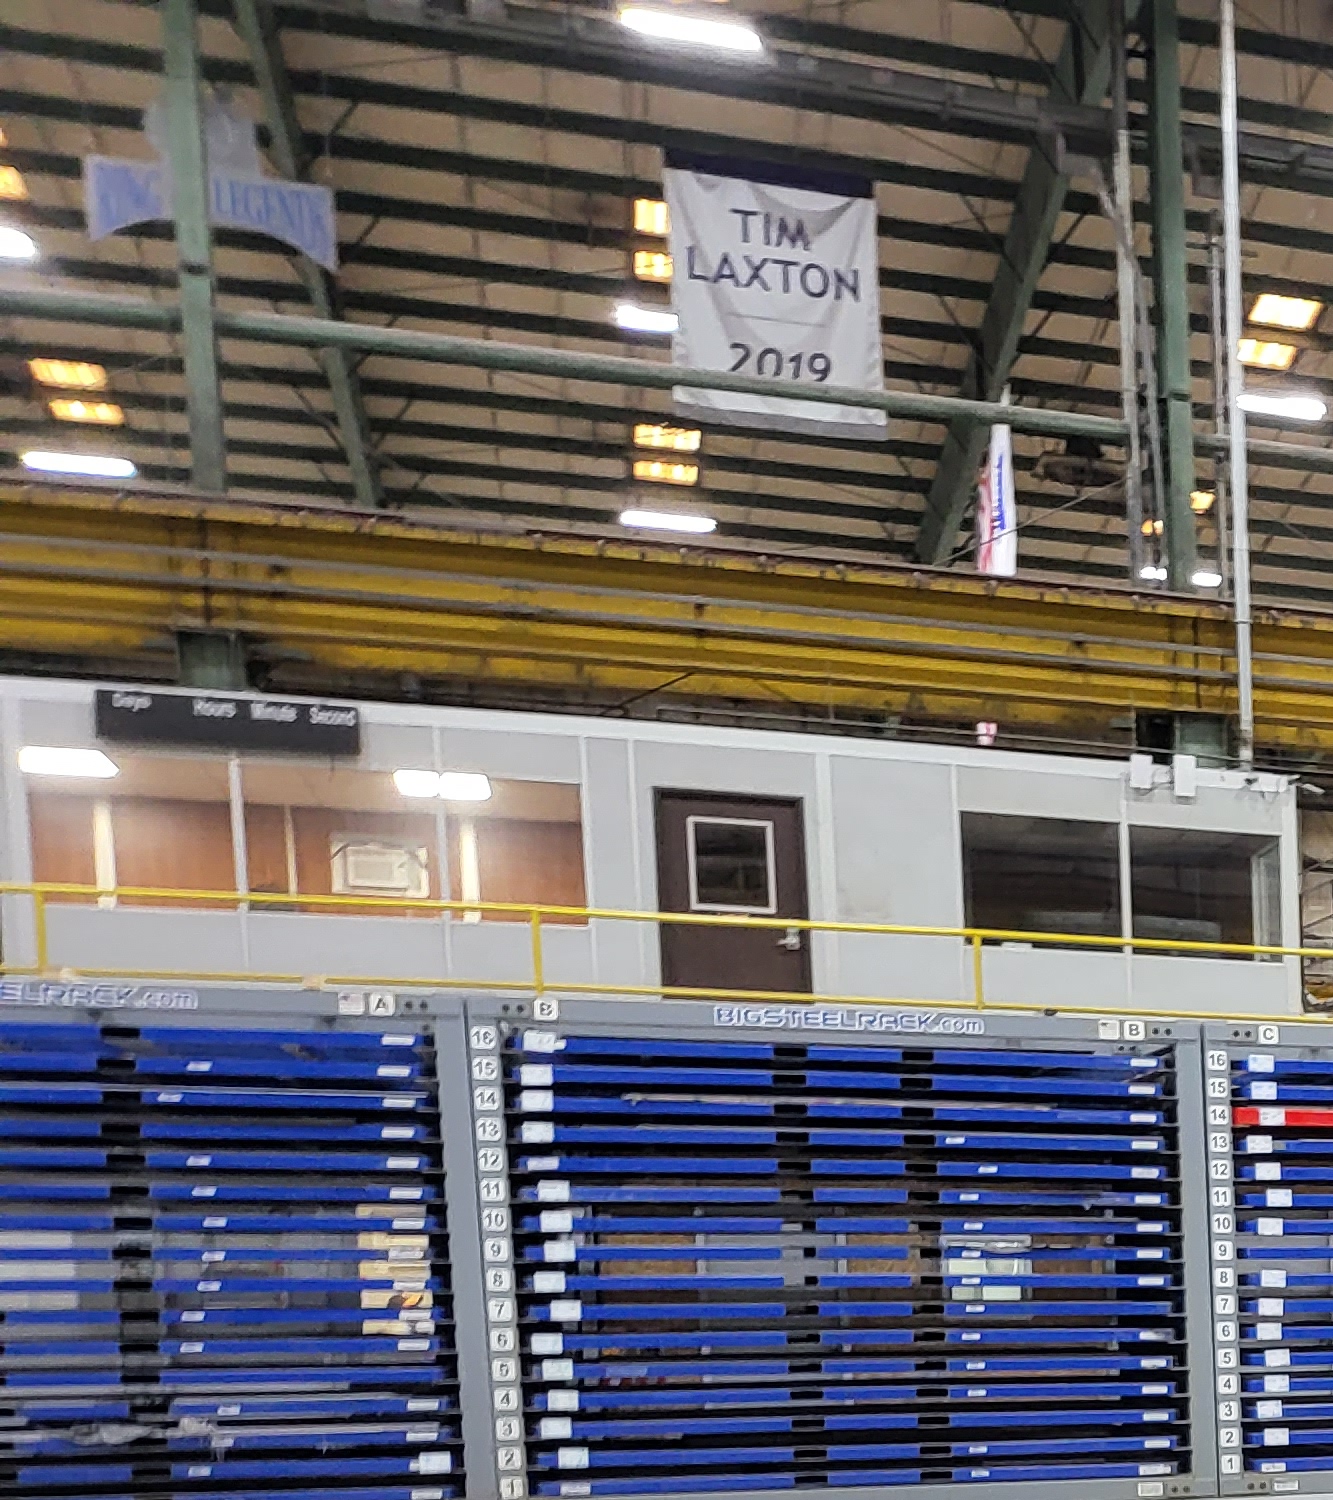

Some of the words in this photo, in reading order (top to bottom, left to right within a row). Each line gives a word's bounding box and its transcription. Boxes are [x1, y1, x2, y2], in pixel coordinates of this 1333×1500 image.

[729, 208, 811, 251] TIM
[686, 245, 861, 302] LAXTON
[730, 342, 832, 382] 2019
[714, 1006, 985, 1035] BIGSTEELRACK.com
[1128, 1023, 1140, 1037] B
[1262, 1027, 1275, 1041] C
[1209, 1054, 1226, 1067] 16
[1210, 1081, 1226, 1094] 15
[1210, 1109, 1227, 1122] 14
[1212, 1136, 1228, 1149] 13
[479, 1153, 500, 1167] 12
[1212, 1163, 1229, 1176] 12
[482, 1183, 501, 1197] 11
[1213, 1190, 1228, 1203] 11
[485, 1213, 504, 1227] 10
[1214, 1217, 1231, 1230] 10
[1218, 1244, 1227, 1257] 9
[1219, 1271, 1228, 1283] 8
[1220, 1298, 1229, 1311] 7
[1222, 1325, 1231, 1338] 6
[1223, 1352, 1232, 1365] 5
[1223, 1377, 1232, 1390] 4
[1224, 1404, 1233, 1417] 3
[1225, 1431, 1234, 1444] 2
